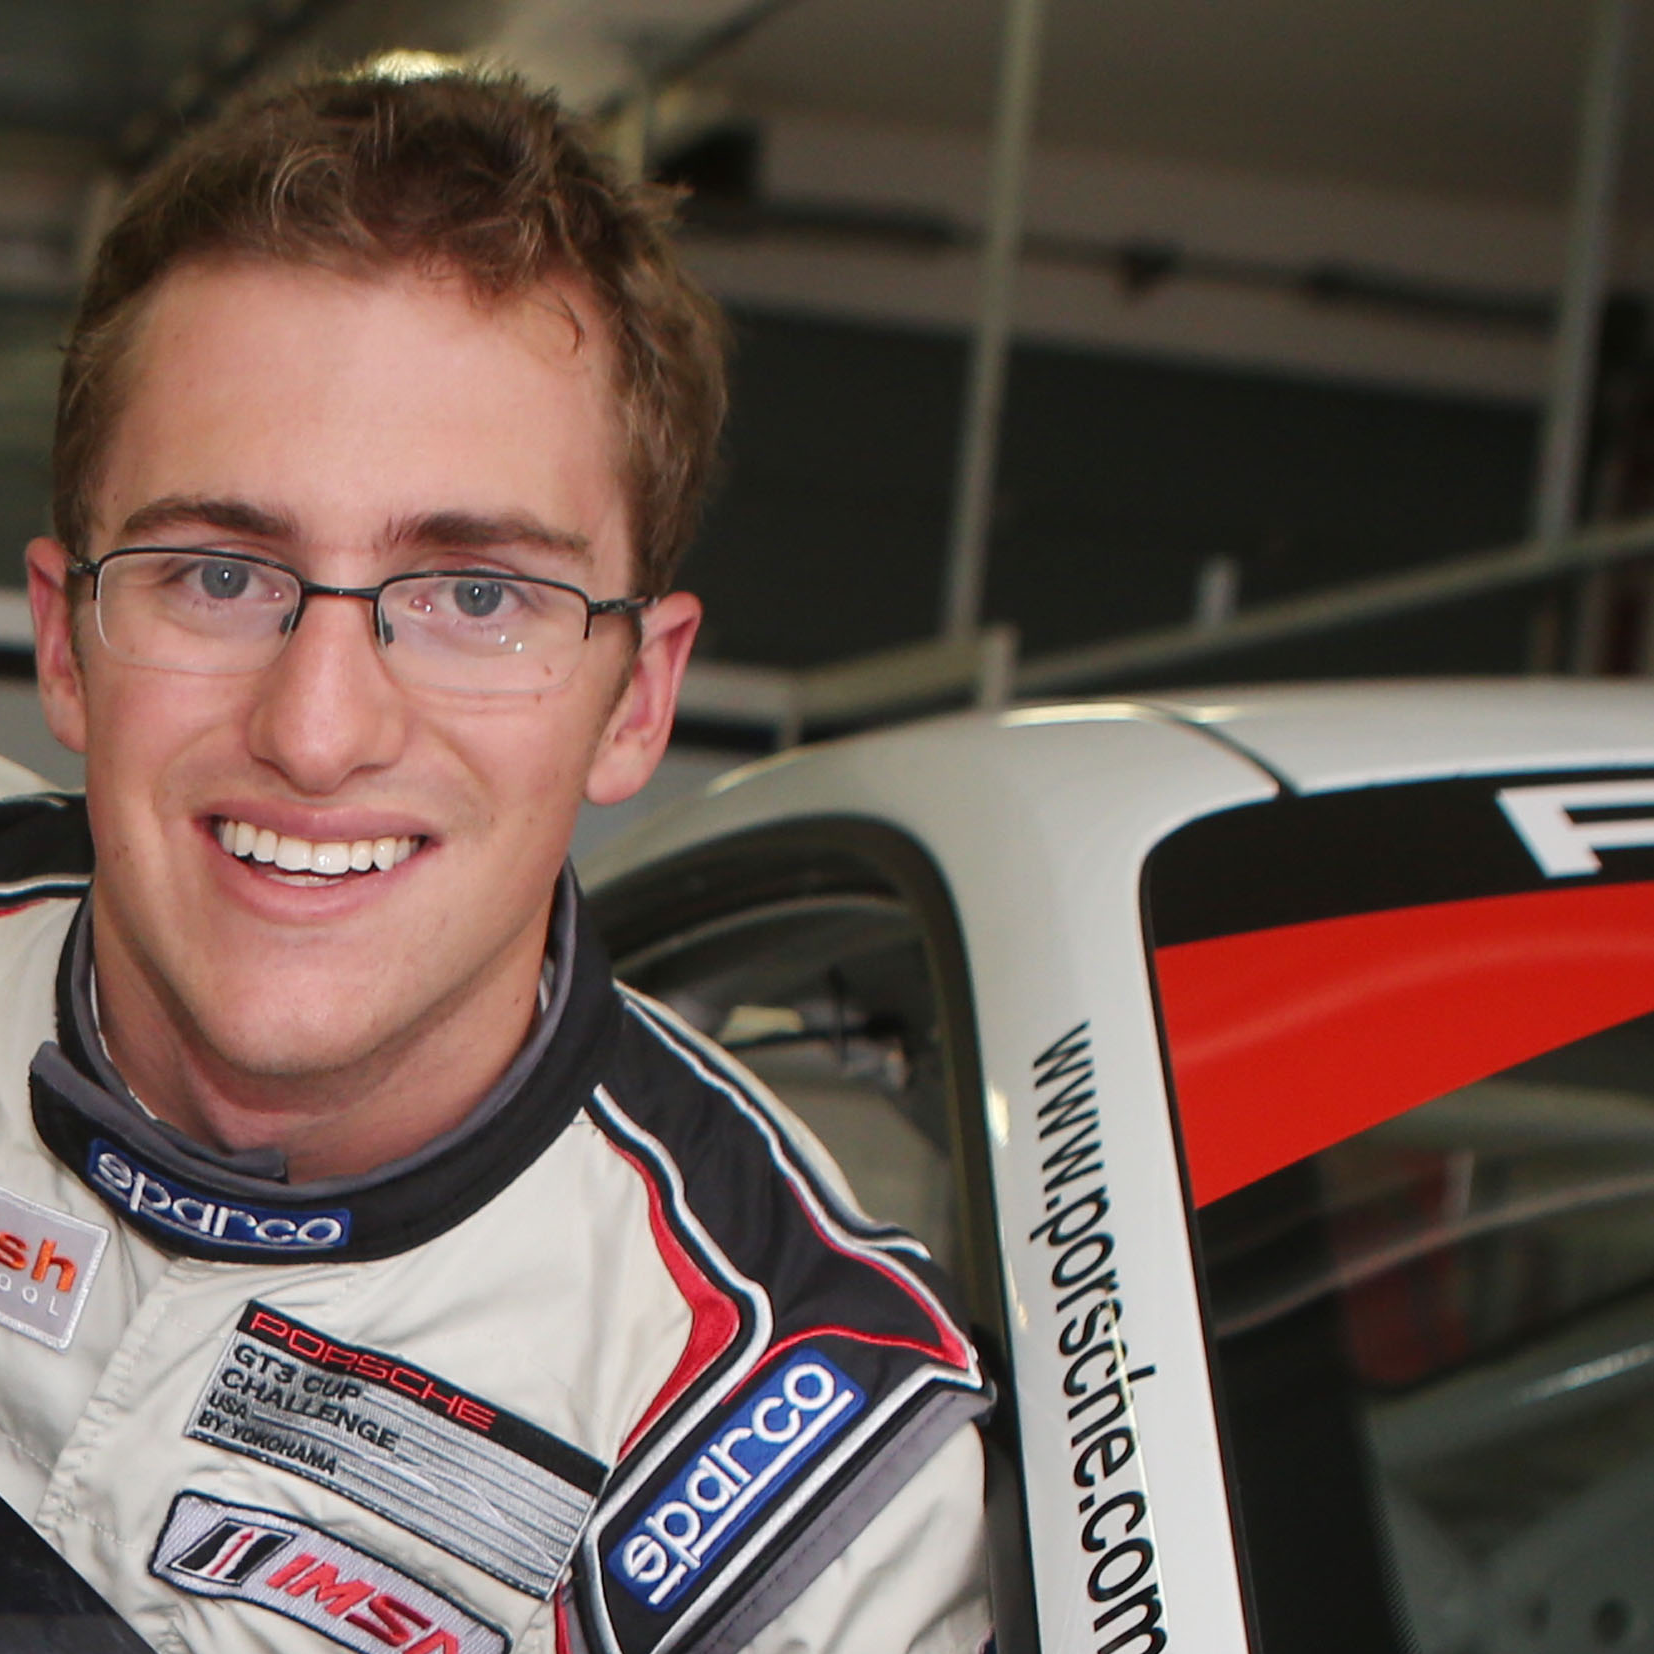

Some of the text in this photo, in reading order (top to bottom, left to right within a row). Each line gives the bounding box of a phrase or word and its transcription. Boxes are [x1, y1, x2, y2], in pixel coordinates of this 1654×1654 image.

[93, 1152, 342, 1249] sparco
[209, 1391, 248, 1419] USA
[221, 1368, 402, 1452] CHALLENGE
[233, 1343, 362, 1401] GT3 CUP
[250, 1311, 497, 1431] PORSCHE
[198, 1410, 340, 1475] BY YOKOHAMA
[622, 1363, 854, 1605] sparco
